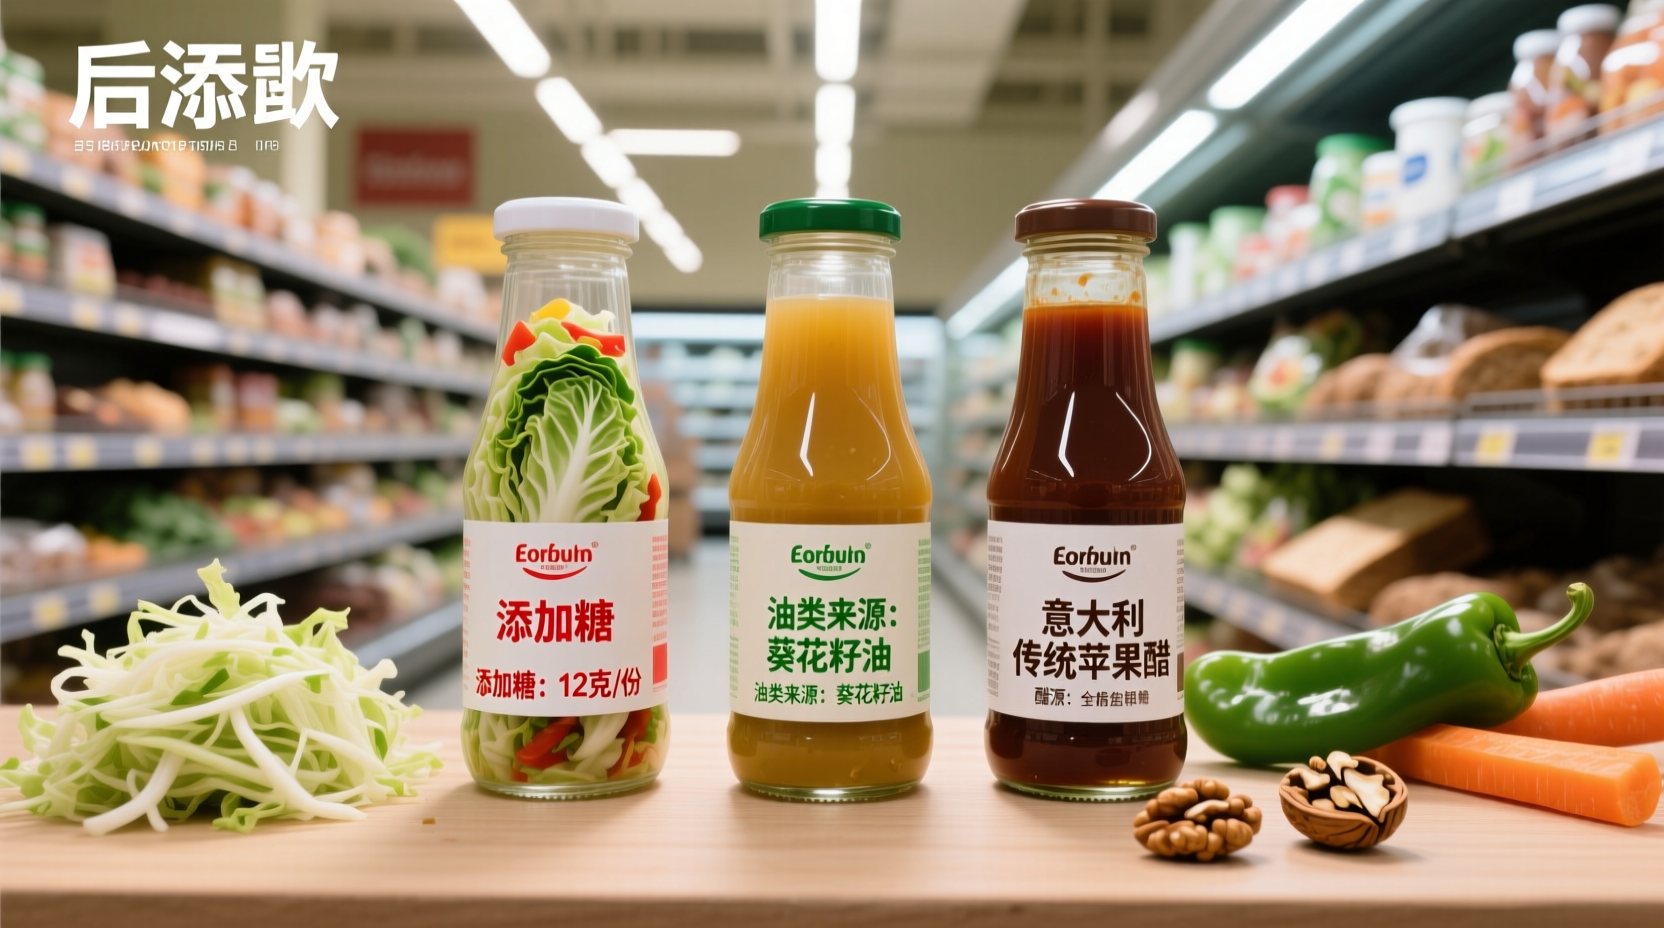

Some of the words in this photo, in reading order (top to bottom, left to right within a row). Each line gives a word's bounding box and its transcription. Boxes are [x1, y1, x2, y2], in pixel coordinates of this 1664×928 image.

[496, 599, 615, 643] 添加糖
[1042, 598, 1144, 638] 意大利
[767, 636, 892, 674] 葵花籽油
[1013, 638, 1171, 681] 传统苹果醋
